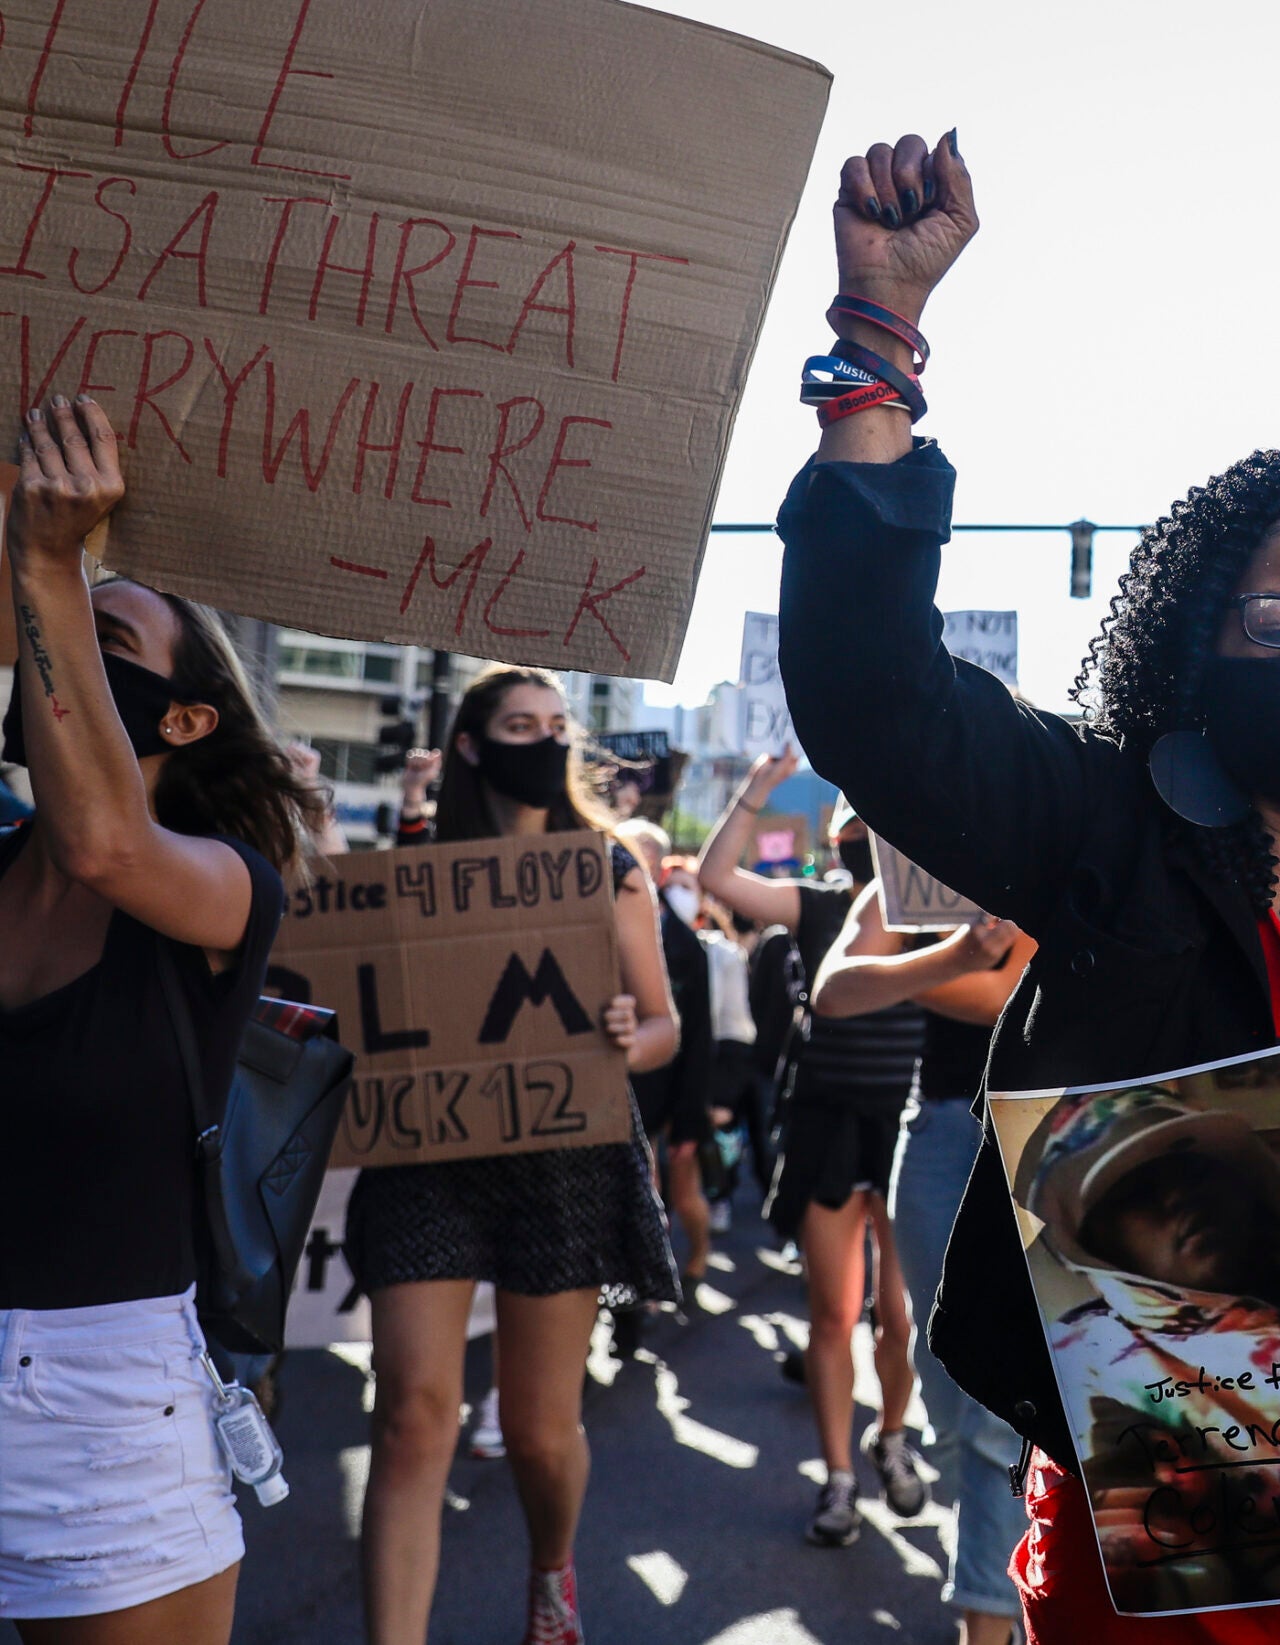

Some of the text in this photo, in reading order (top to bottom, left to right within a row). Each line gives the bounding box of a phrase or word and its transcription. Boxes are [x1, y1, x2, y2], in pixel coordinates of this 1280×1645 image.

[0, 0, 351, 180] TICE
[0, 162, 689, 383] IS A THREAT
[0, 311, 613, 533] VERYWHERE
[282, 846, 602, 918] stice 4 FLOYD
[341, 1059, 588, 1155] UCK 12
[1144, 1365, 1256, 1404] Justice
